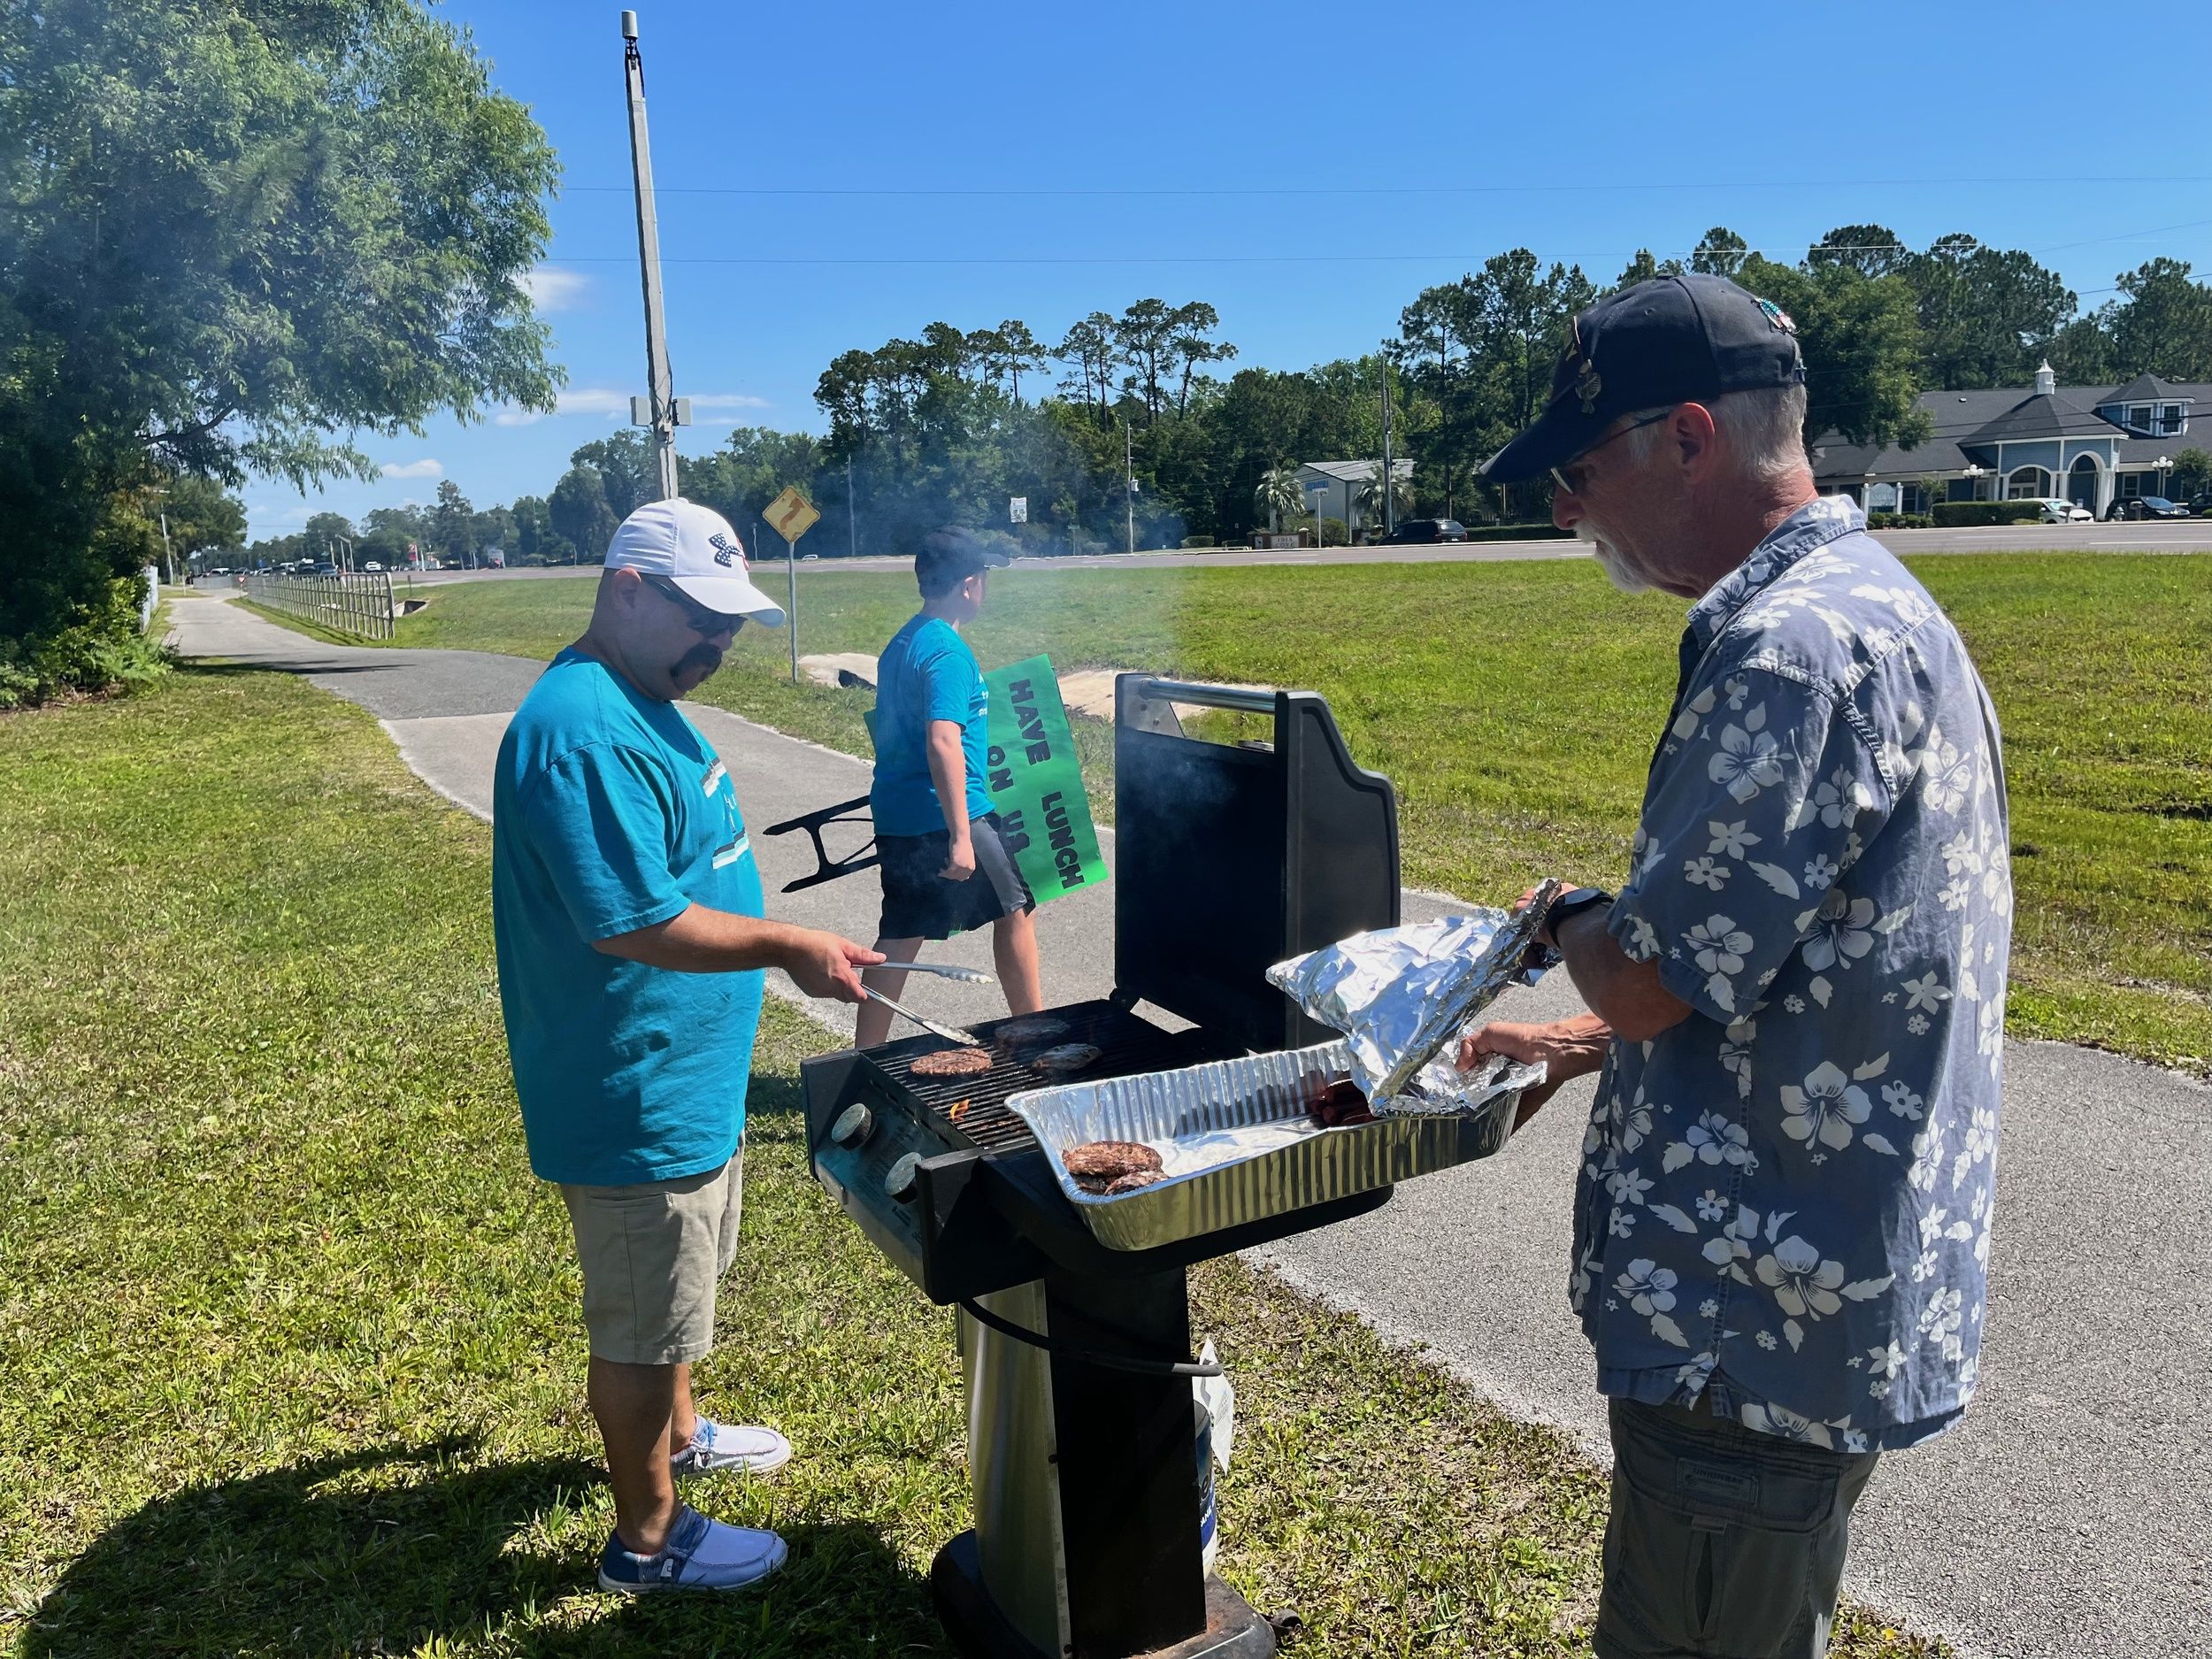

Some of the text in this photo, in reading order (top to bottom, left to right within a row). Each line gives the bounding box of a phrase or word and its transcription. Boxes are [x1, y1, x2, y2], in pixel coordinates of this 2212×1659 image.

[987, 745, 1014, 793] ON
[1009, 679, 1085, 889] HAVE LUNCH
